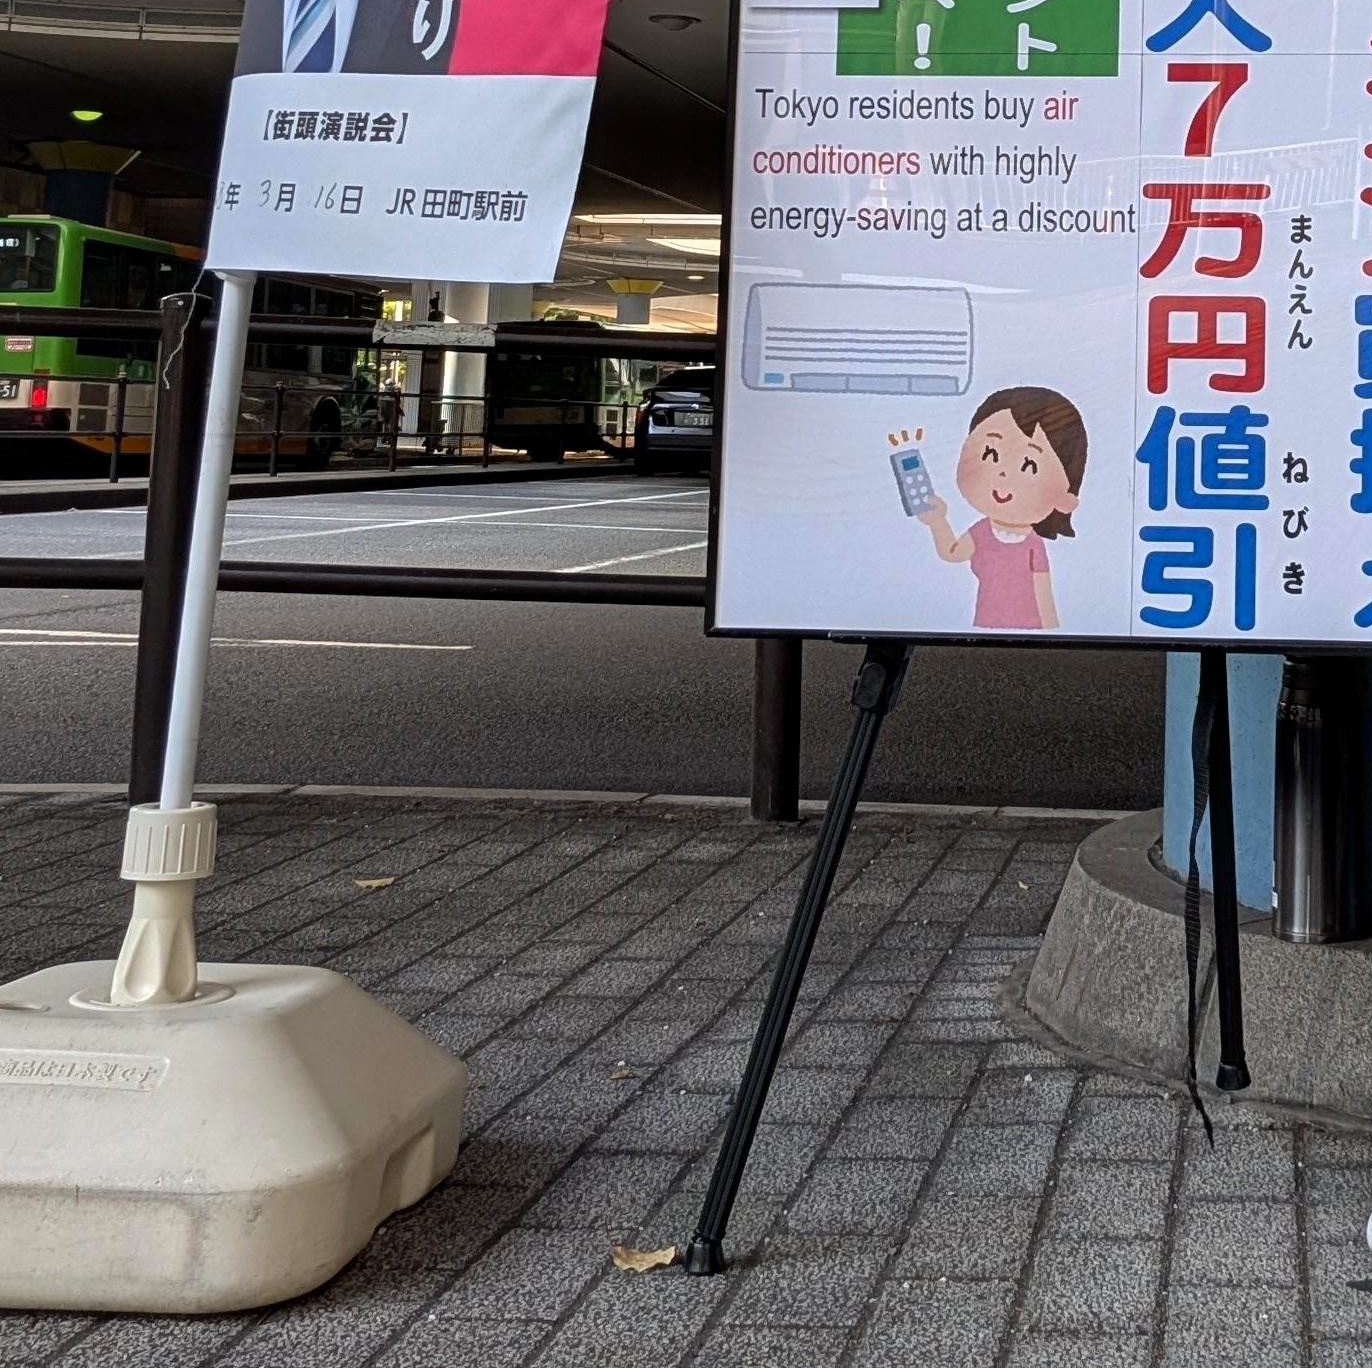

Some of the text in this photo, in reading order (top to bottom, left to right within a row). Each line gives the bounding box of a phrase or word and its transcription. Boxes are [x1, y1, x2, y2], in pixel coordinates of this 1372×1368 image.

[262, 109, 409, 145] 【街頭演説会】
[755, 88, 1080, 128] Tokyo residents buy air
[752, 144, 1078, 184] conditioners with highly
[386, 187, 528, 222] JR田町駅前
[750, 201, 1136, 239] energy-saving at a discount
[1286, 214, 1313, 351] まんえん
[1281, 451, 1310, 595] ねびき
